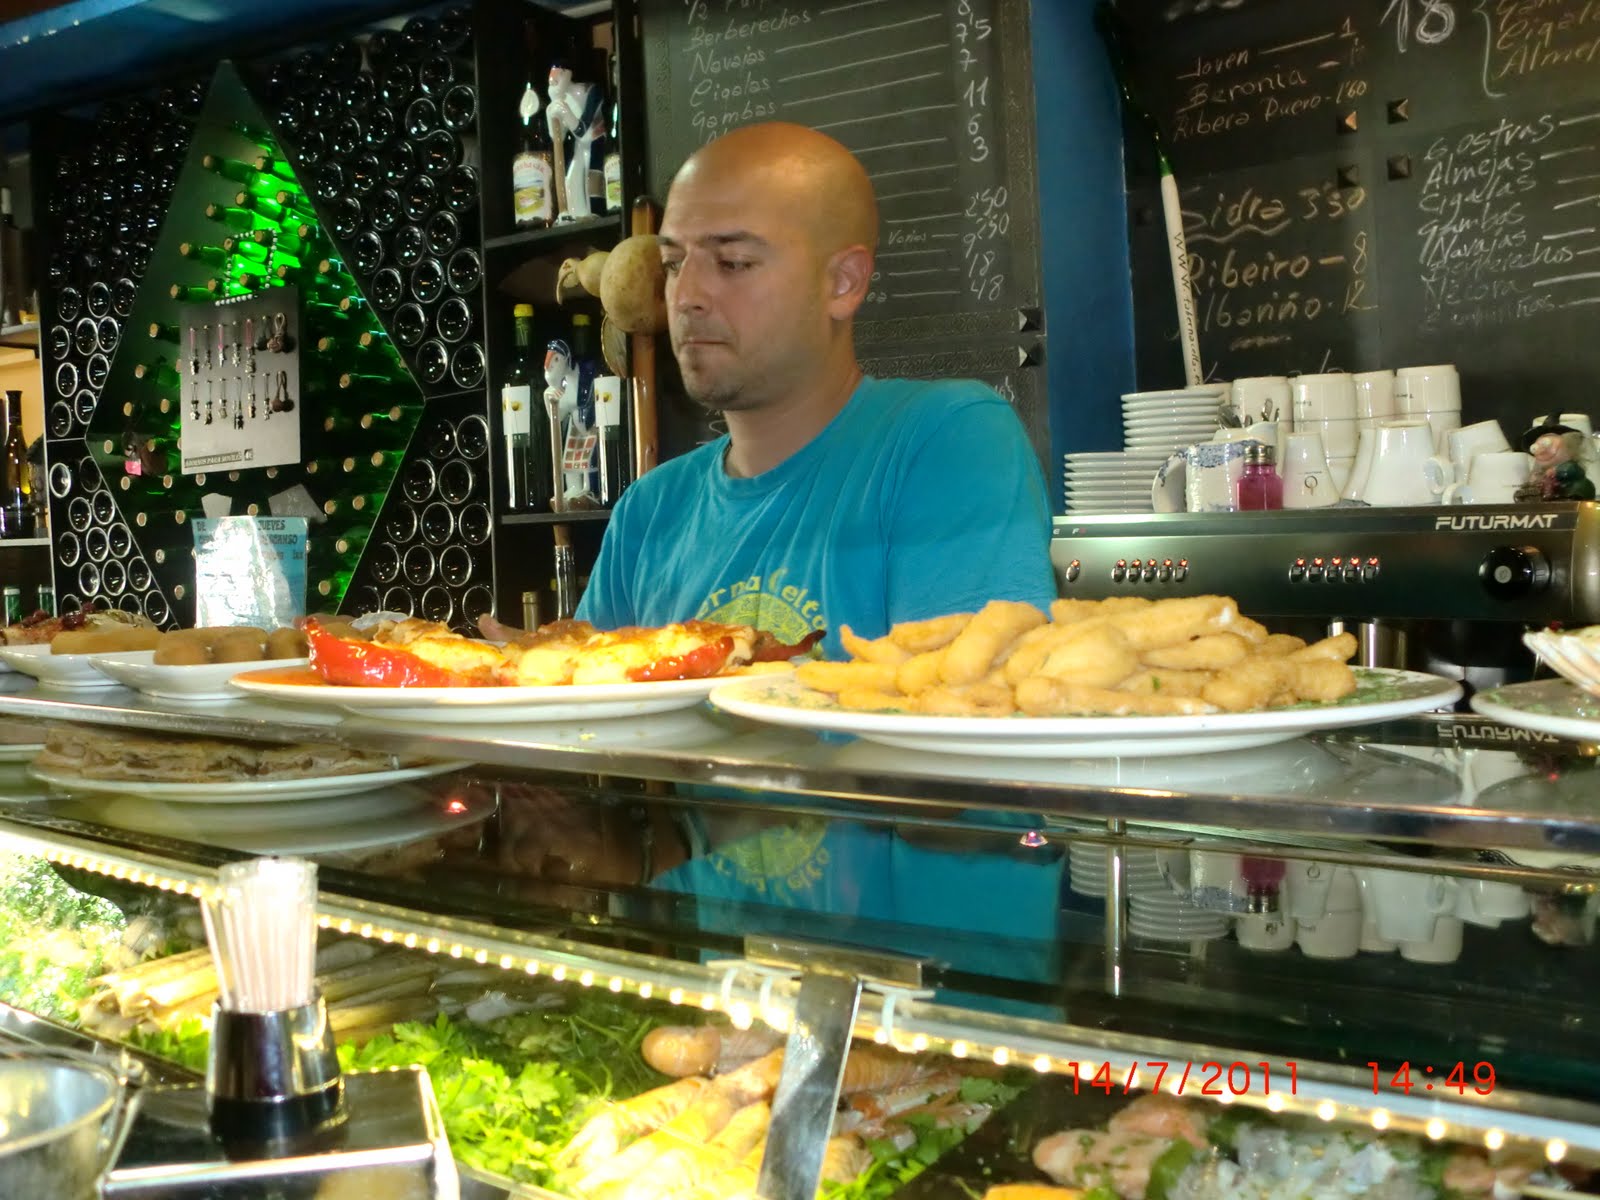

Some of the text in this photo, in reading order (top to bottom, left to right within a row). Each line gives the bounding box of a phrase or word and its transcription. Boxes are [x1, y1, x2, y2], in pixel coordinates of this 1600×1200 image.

[684, 10, 812, 50] Berberechos
[959, 48, 978, 73] 7
[963, 76, 989, 108] 11
[692, 103, 982, 136] Gambas 6
[970, 136, 989, 162] 3
[963, 232, 976, 259] 9
[1435, 514, 1558, 531] FUTURMAT
